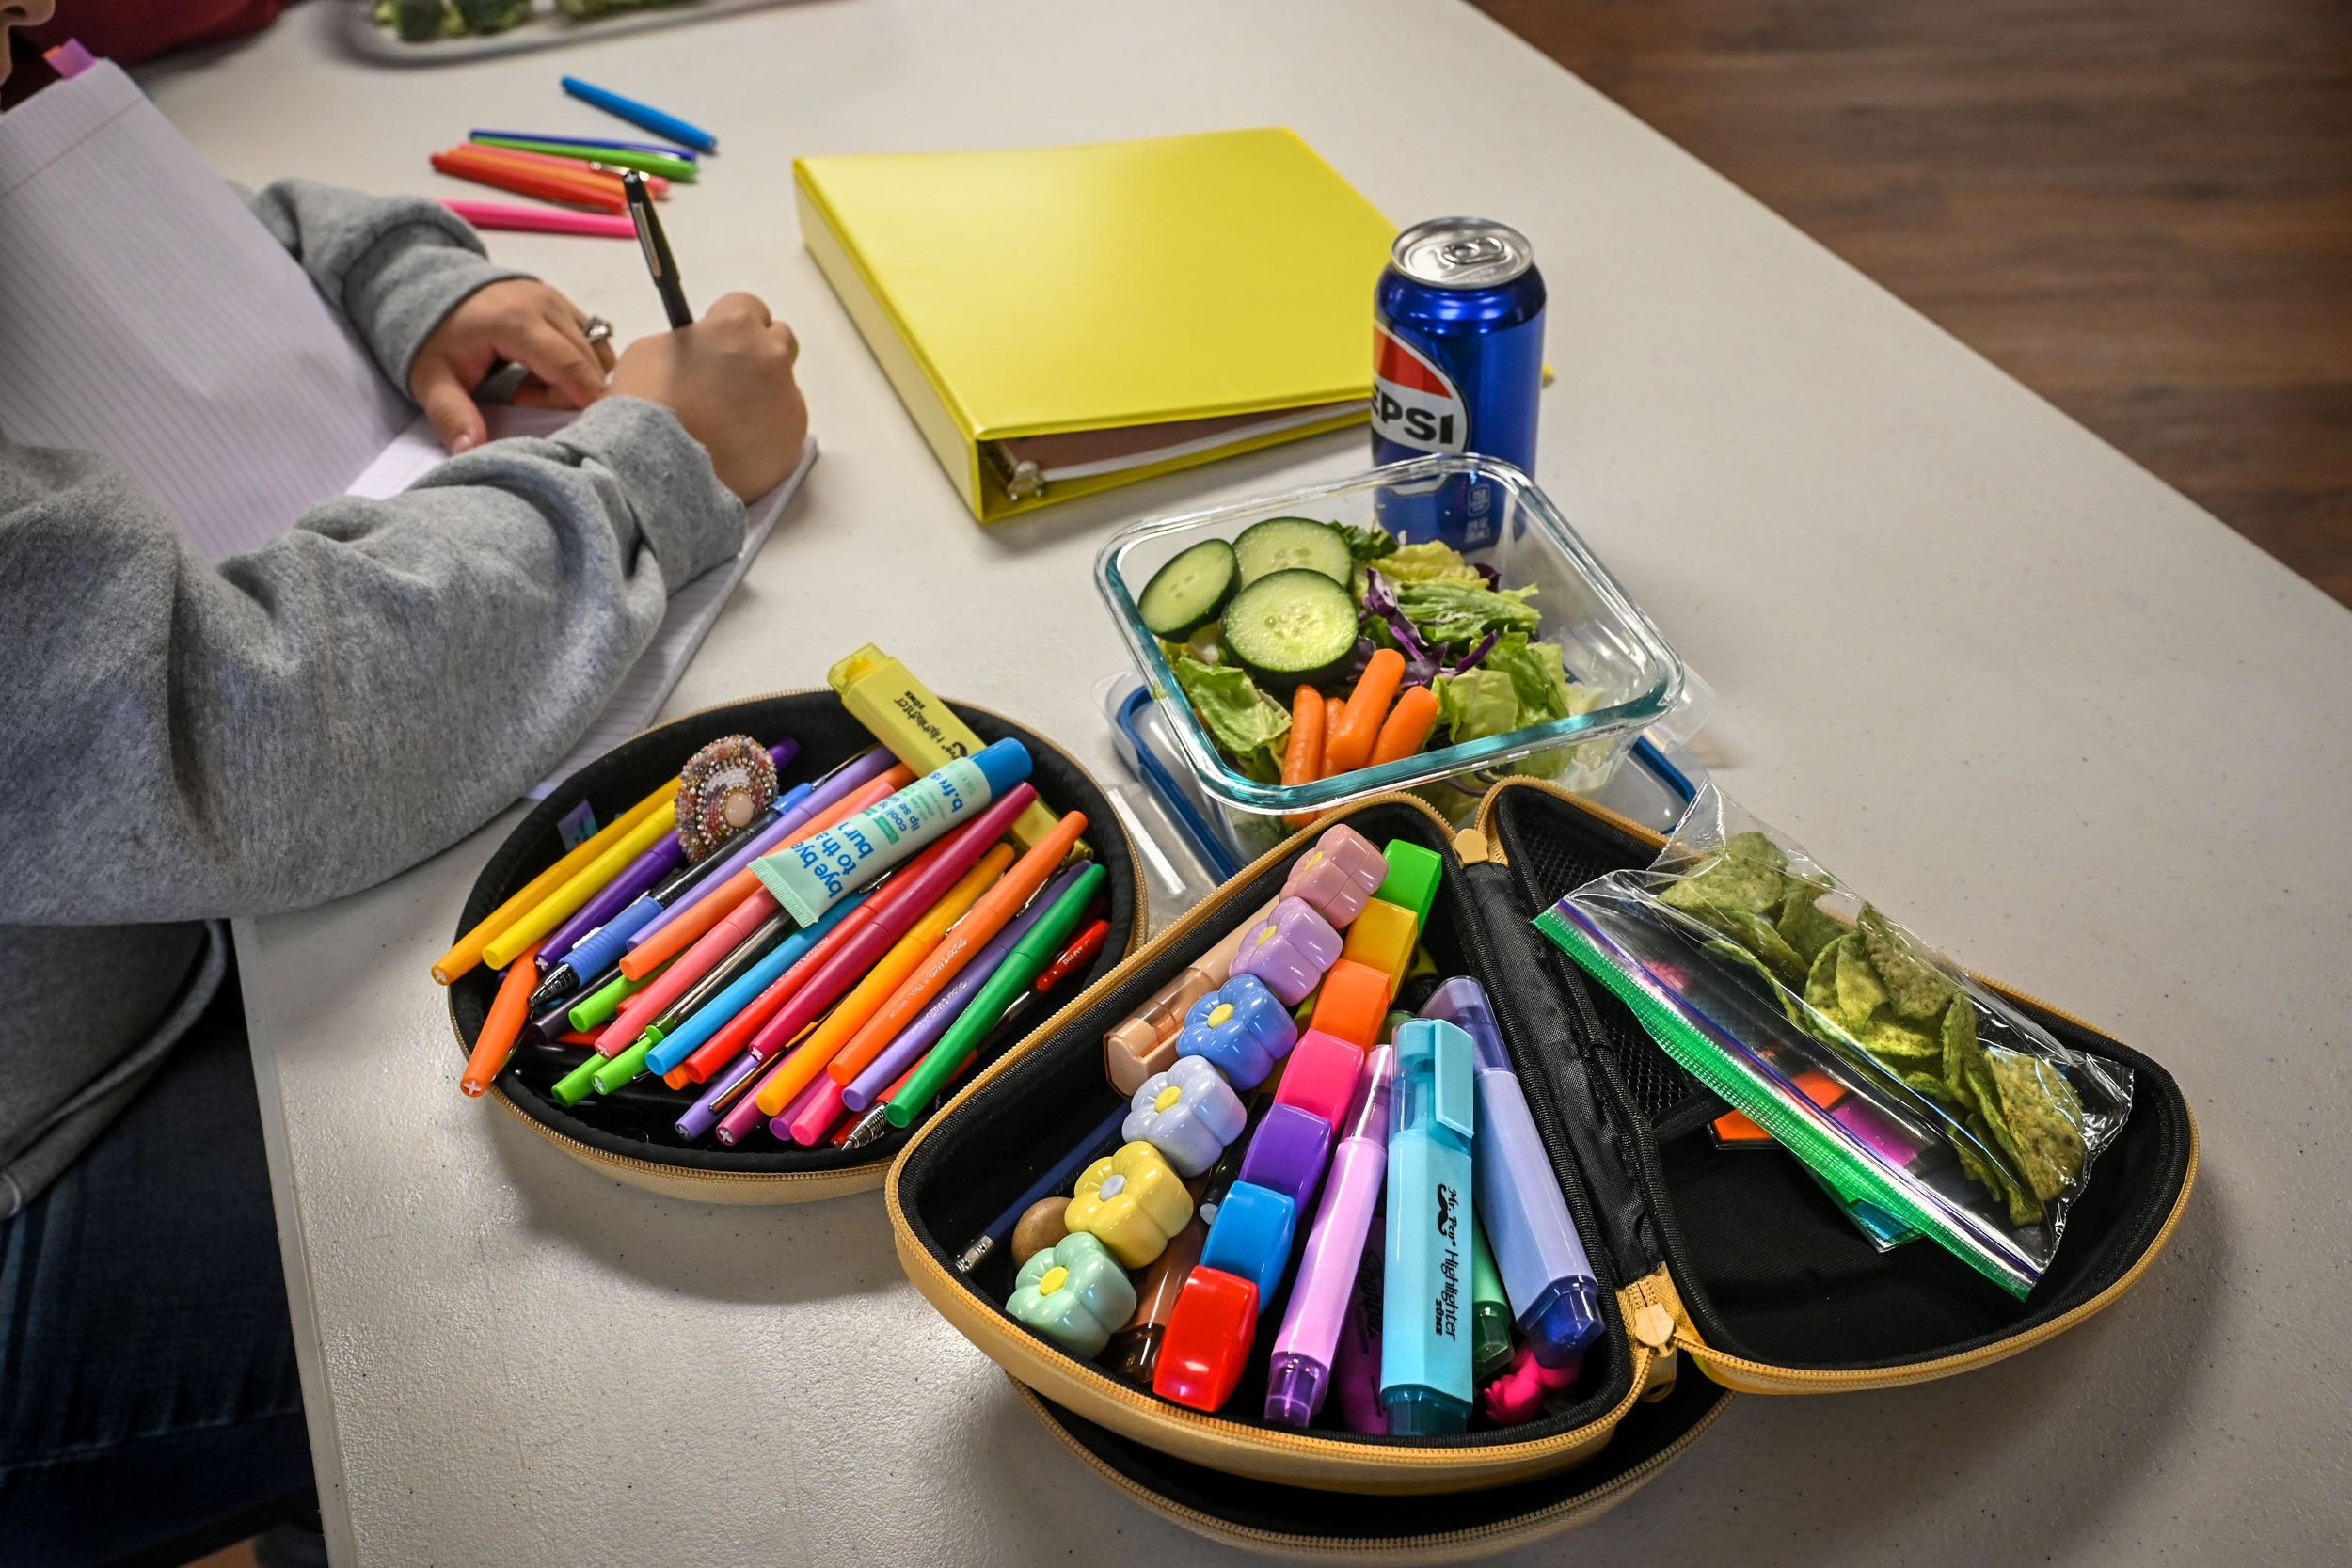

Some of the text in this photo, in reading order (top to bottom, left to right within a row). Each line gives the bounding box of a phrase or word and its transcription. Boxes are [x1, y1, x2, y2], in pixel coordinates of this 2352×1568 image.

[1372, 383, 1454, 444] EPSI
[893, 697, 946, 745] Highlighter
[838, 821, 875, 860] burn
[909, 816, 921, 832] lip
[791, 841, 844, 898] bye bye
[816, 832, 857, 875] to the
[1447, 1188, 1458, 1212] Mr.
[1439, 1248, 1458, 1341] Highlighter
